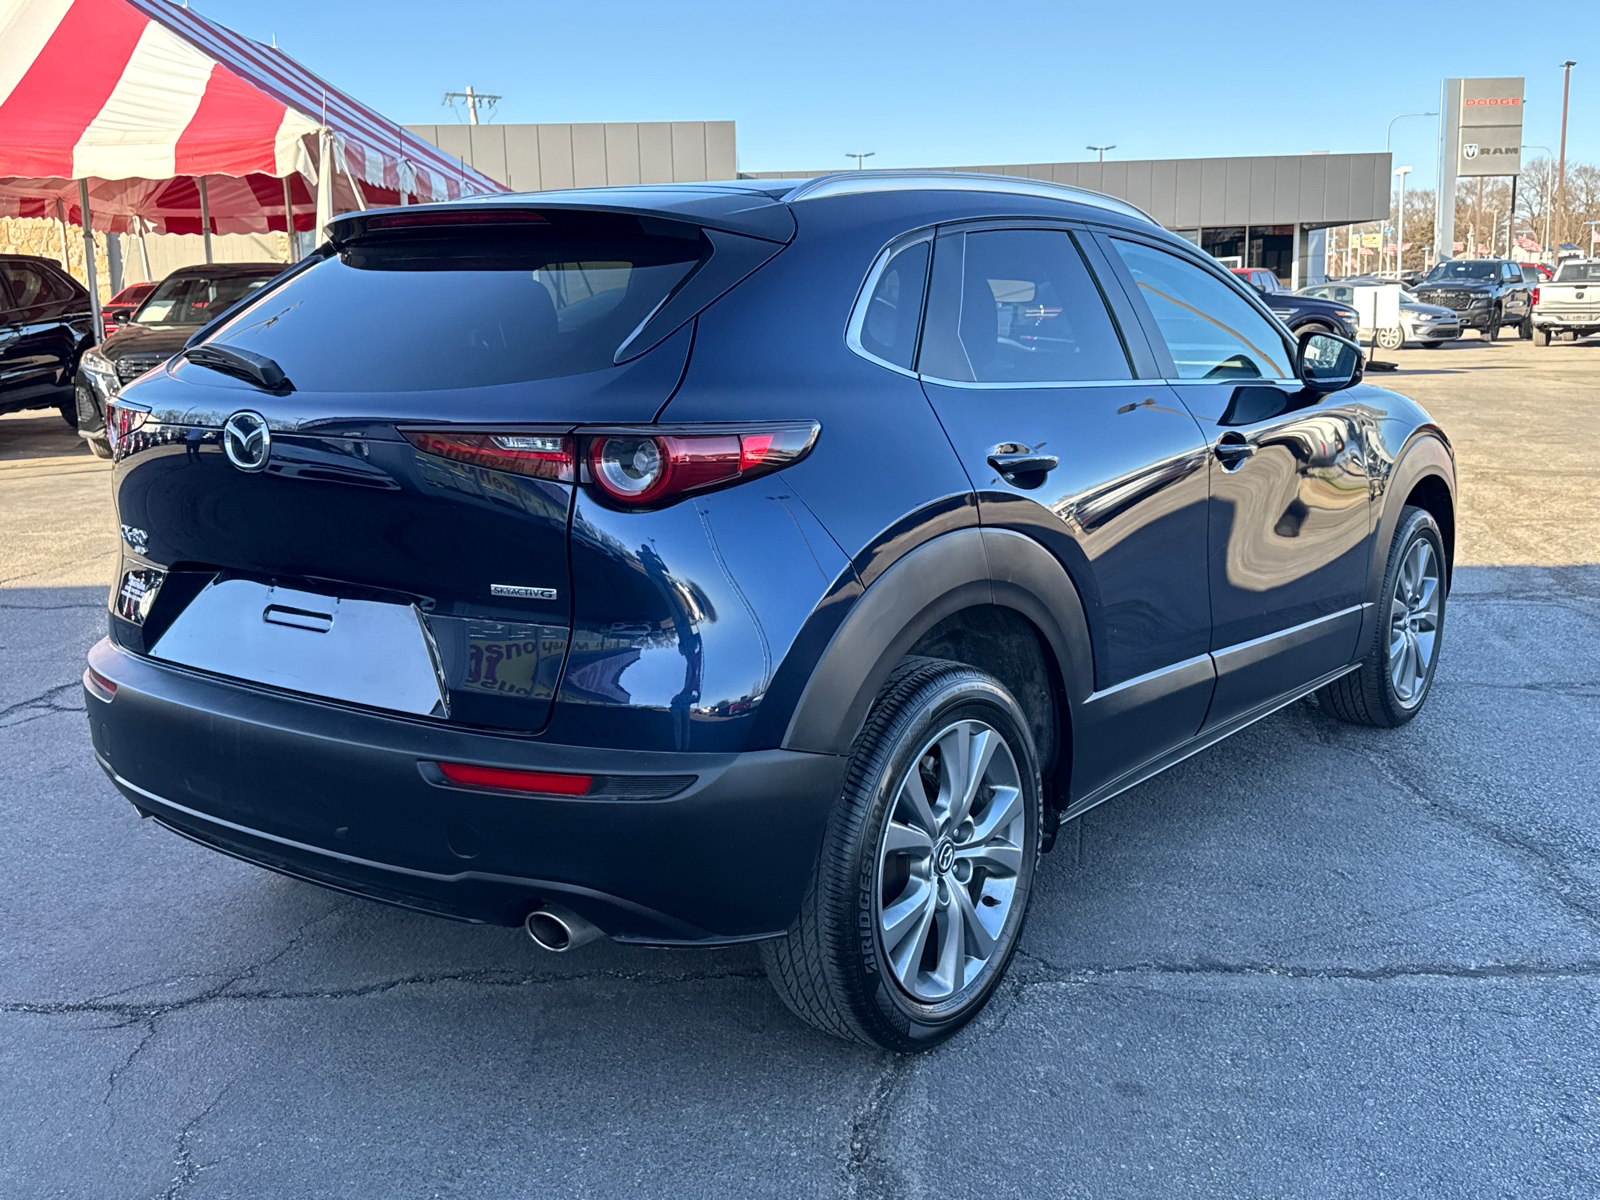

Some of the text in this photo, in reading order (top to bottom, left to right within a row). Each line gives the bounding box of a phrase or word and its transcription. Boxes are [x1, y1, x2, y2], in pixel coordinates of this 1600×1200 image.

[1465, 98, 1521, 107] DODGE
[1480, 147, 1519, 155] RAM
[858, 791, 887, 975] BRIDGESTONE
